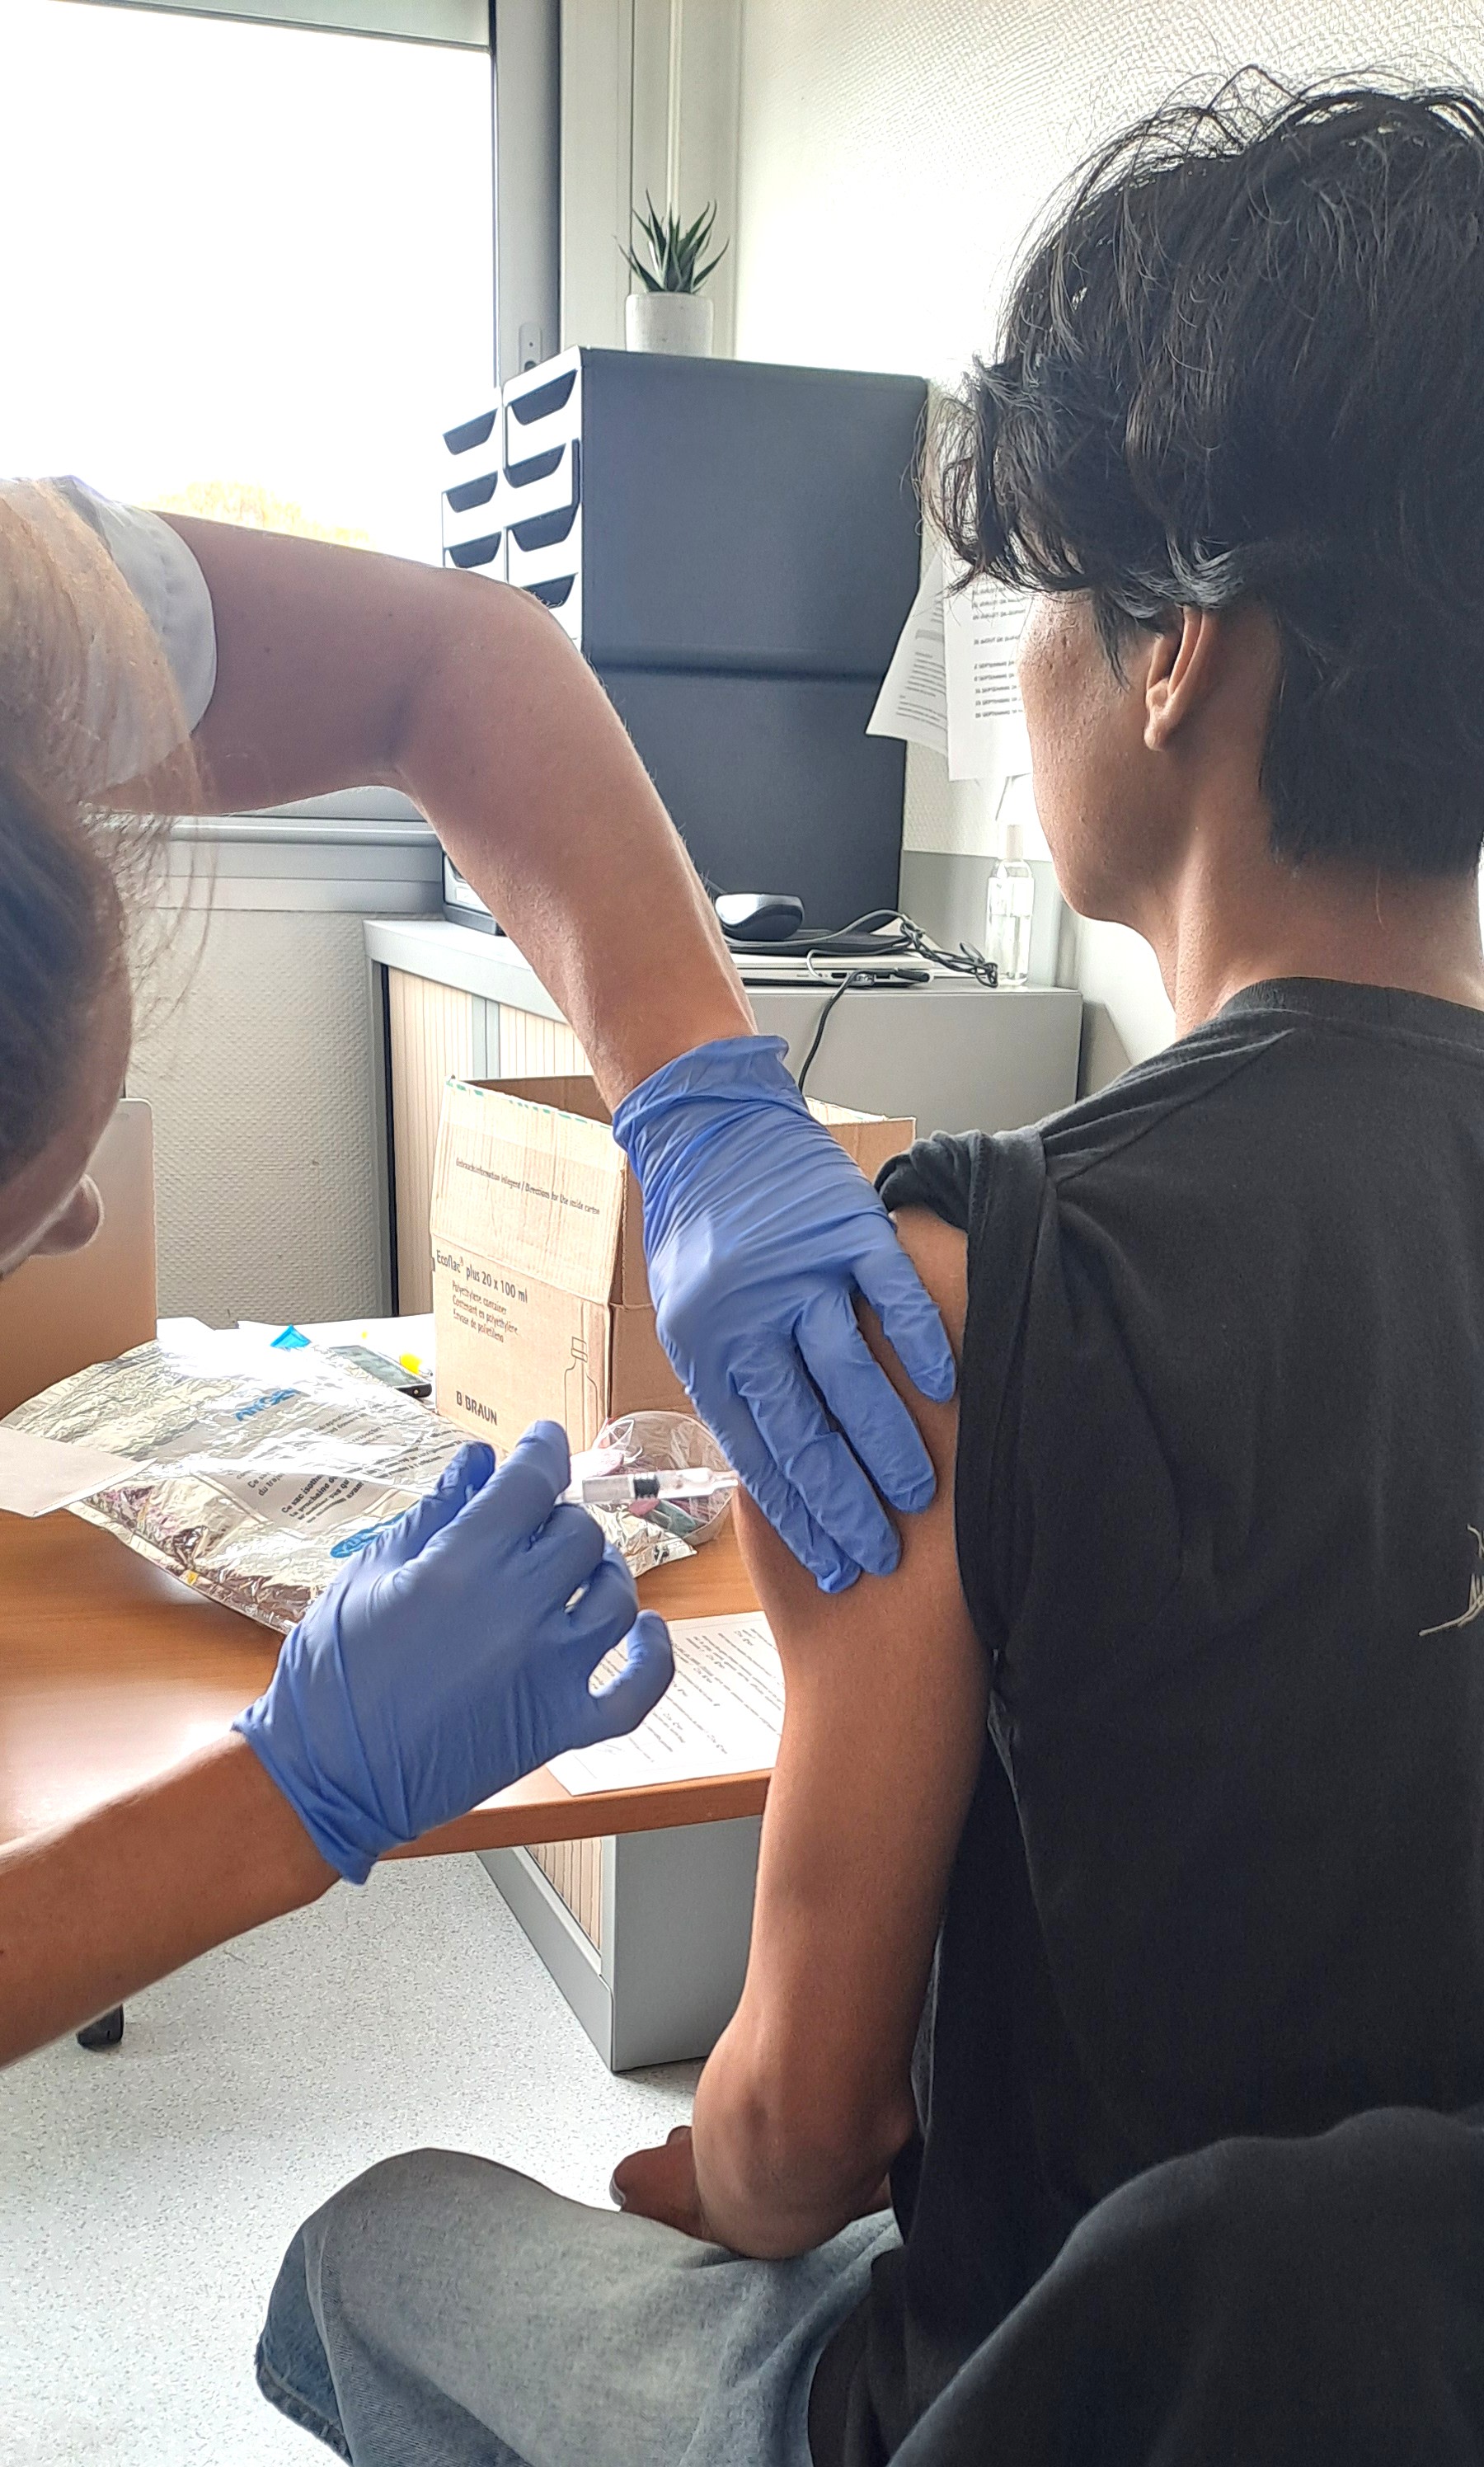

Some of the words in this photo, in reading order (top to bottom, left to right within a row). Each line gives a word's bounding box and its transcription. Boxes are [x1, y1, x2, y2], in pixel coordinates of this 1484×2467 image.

[466, 1264, 480, 1283] plus
[481, 1271, 492, 1287] 20
[500, 1280, 516, 1299] 100
[518, 1287, 528, 1304] ml
[464, 1396, 498, 1426] BRAUN
